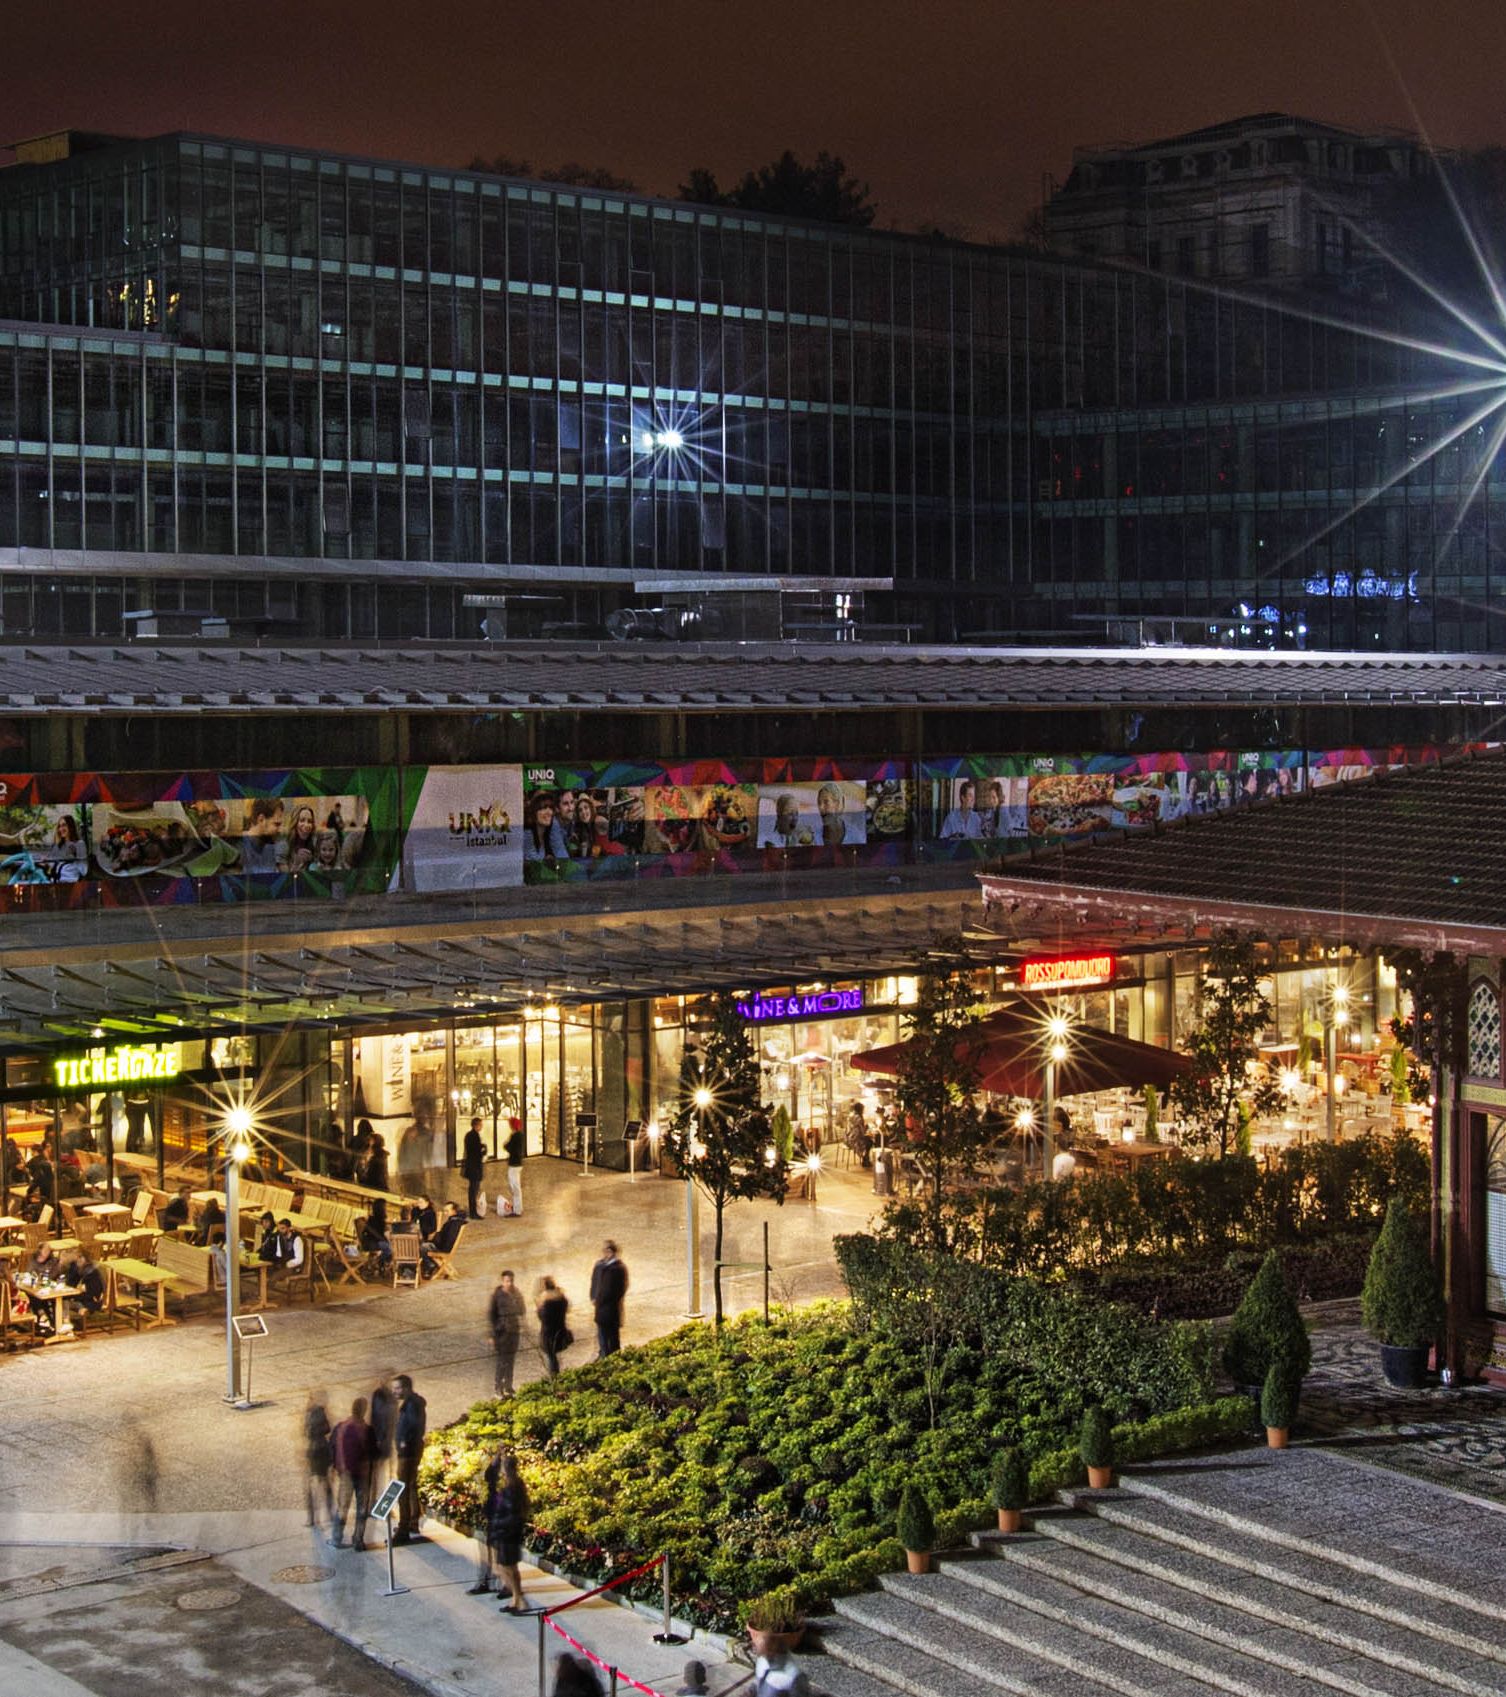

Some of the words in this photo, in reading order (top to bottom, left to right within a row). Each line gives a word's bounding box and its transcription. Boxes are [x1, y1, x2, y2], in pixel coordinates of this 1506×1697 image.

[528, 769, 555, 780] UNIQ
[449, 804, 512, 834] UNIQ
[787, 997, 800, 1015] &
[803, 990, 861, 1014] MORE
